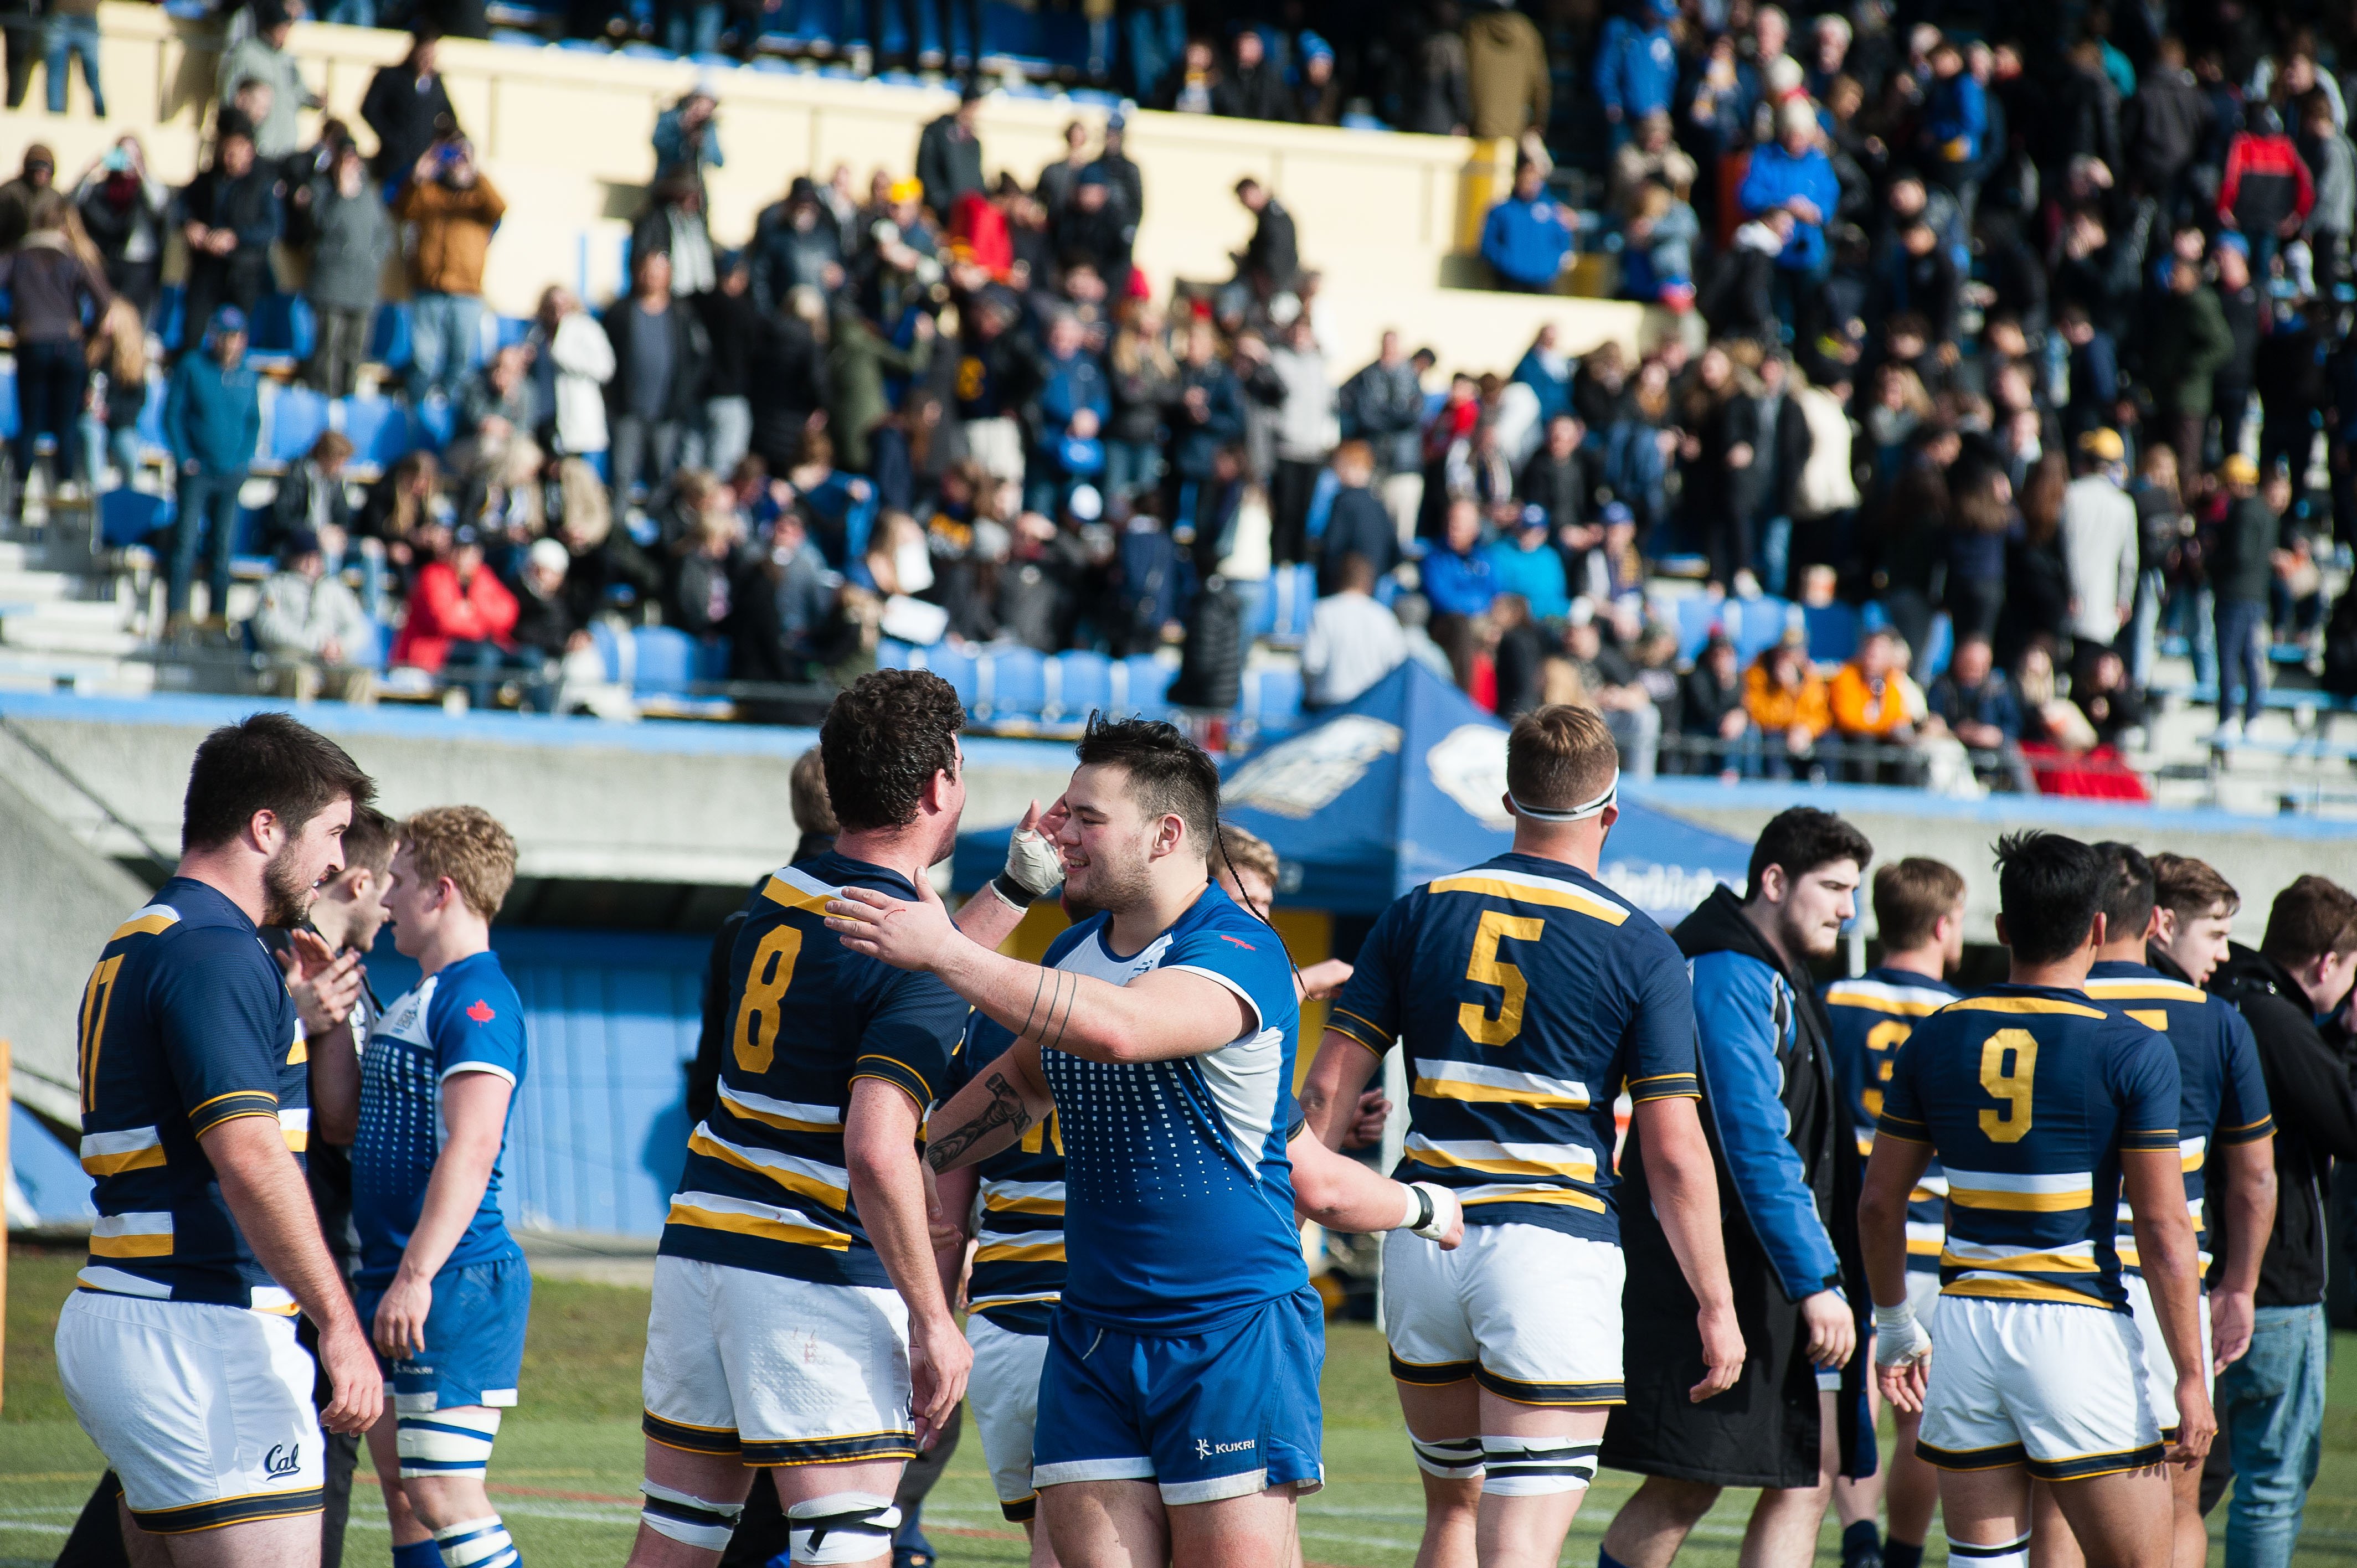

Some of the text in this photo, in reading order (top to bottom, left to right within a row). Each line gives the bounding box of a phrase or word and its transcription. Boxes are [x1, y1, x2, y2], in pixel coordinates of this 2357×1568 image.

[733, 924, 802, 1074] 8
[1458, 910, 1545, 1046] 5
[1978, 1028, 2038, 1143] 9
[264, 1443, 301, 1481] Cal
[1216, 1440, 1255, 1454] KUKRI
